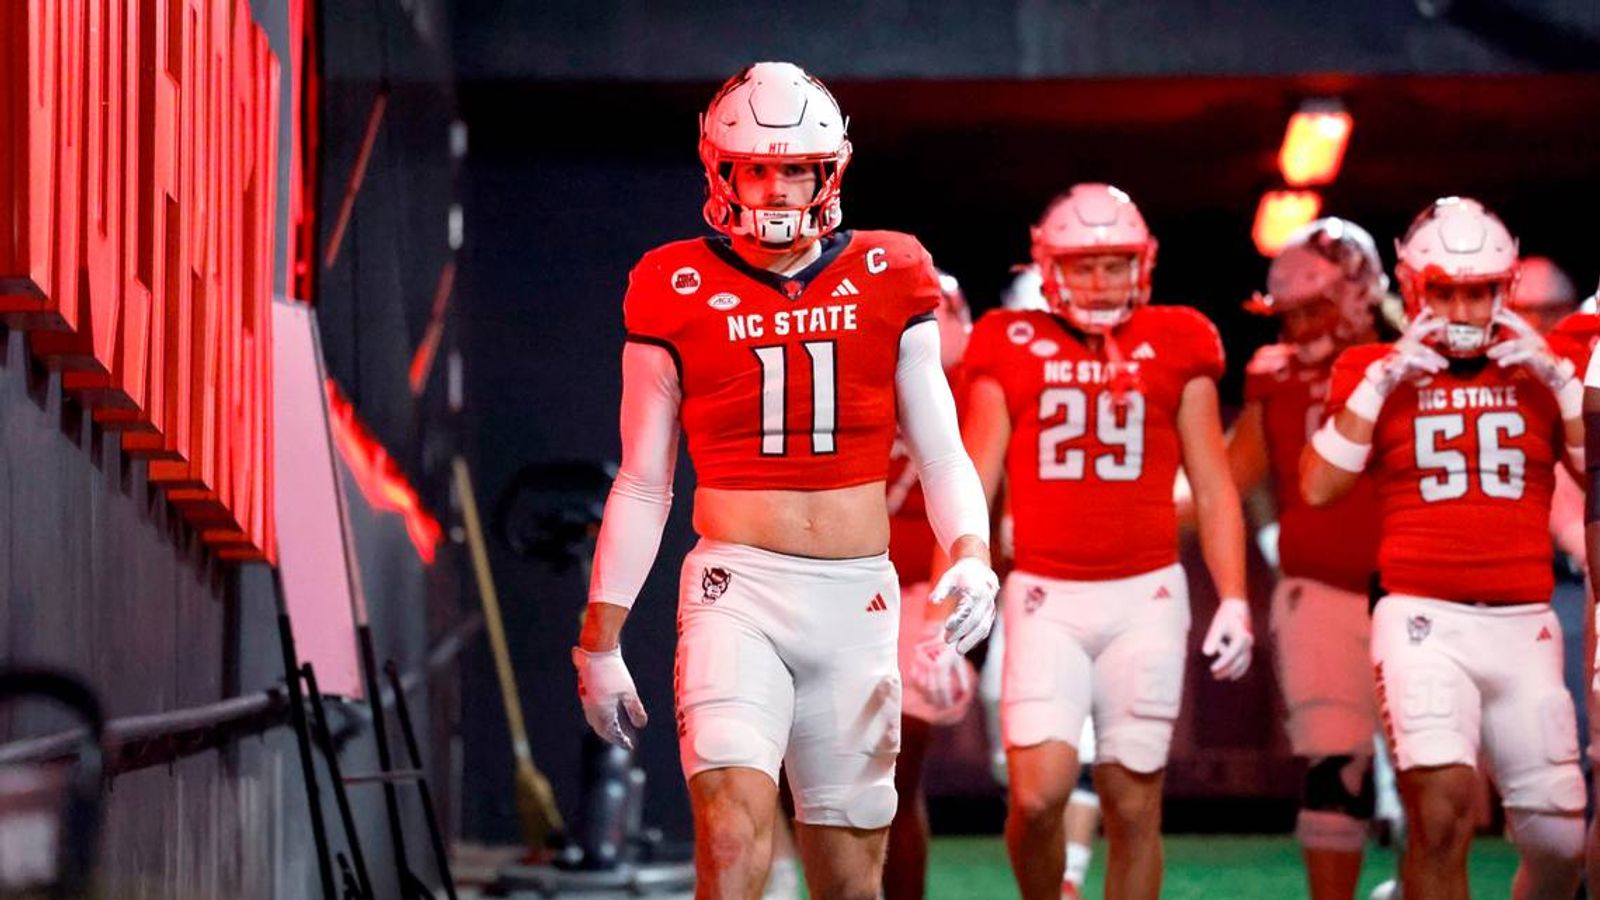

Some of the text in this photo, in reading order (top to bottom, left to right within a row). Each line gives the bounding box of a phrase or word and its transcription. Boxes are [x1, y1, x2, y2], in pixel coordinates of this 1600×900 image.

[866, 247, 889, 275] C
[727, 303, 858, 342] NC STATE
[1044, 360, 1139, 385] NC STA
[751, 340, 838, 457] 11
[1418, 385, 1518, 411] NC STATE
[1038, 388, 1146, 481] 29
[1414, 411, 1527, 503] 56
